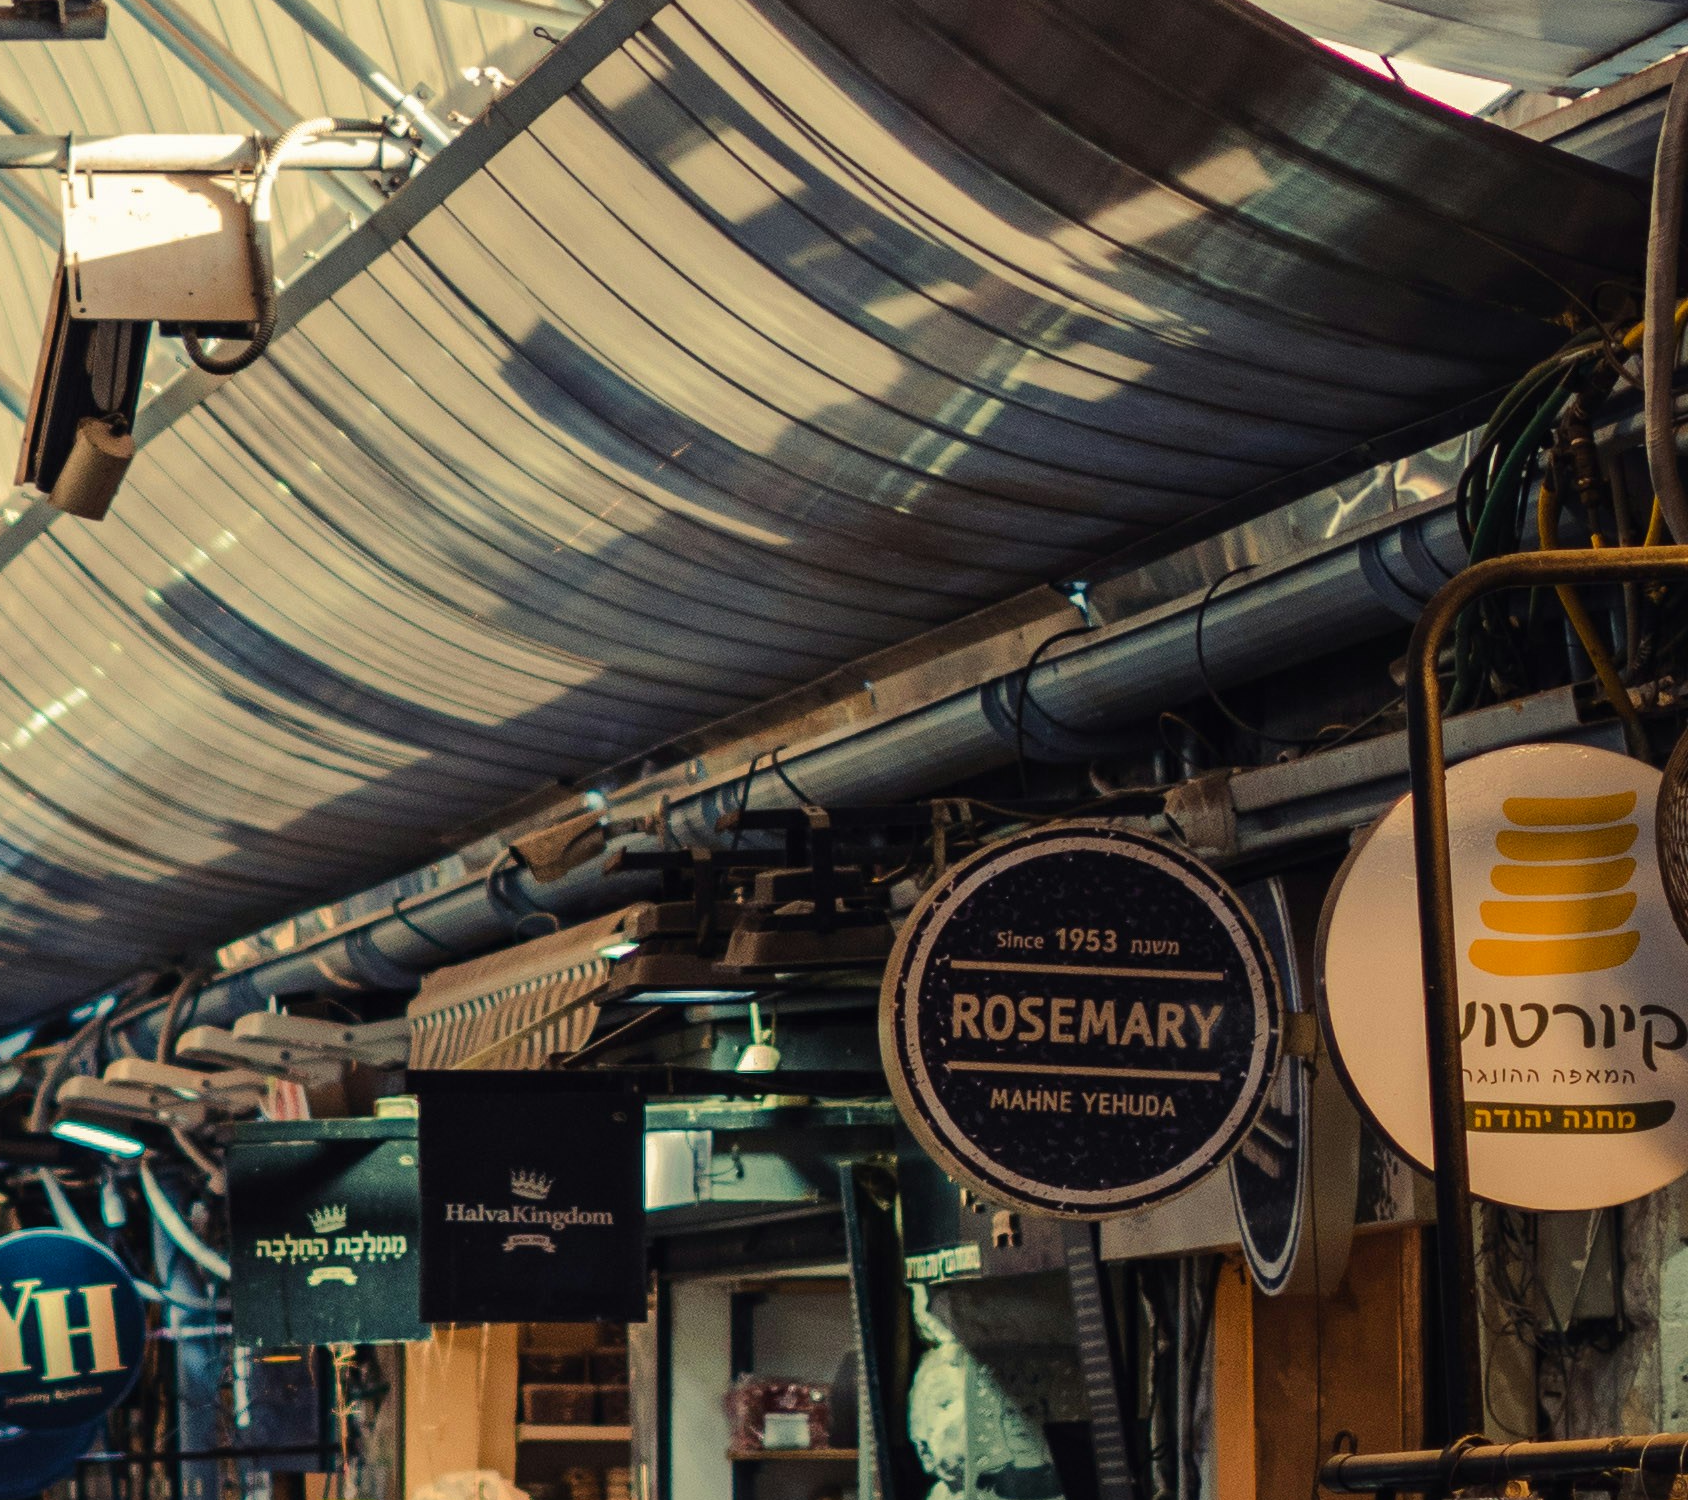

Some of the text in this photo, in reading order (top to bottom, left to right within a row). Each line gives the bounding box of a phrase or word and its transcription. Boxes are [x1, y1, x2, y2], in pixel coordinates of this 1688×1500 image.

[996, 927, 1180, 957] Since 1953 משנת
[951, 993, 1224, 1049] ROSEMARY
[1552, 1068, 1636, 1085] המאפה
[989, 1087, 1177, 1118] MAHNE YEHUDA
[1474, 1108, 1637, 1129] מחנה יהודה
